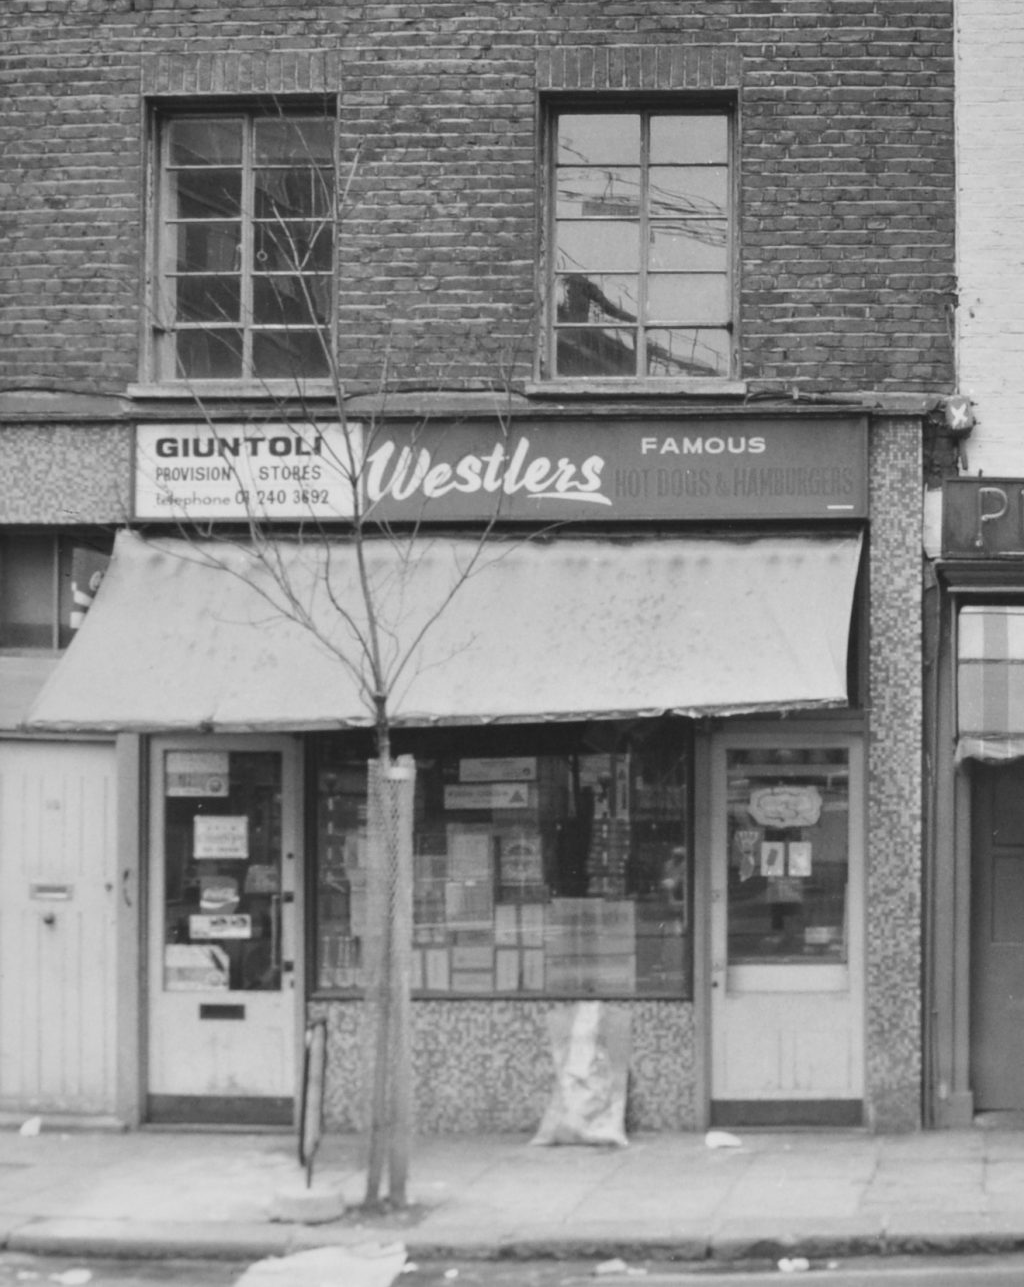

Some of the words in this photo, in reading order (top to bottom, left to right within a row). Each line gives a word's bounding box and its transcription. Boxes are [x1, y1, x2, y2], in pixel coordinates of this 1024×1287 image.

[156, 436, 322, 457] GIUNTOLI
[641, 437, 766, 454] FAMOUS
[156, 466, 231, 481] PROVISION
[259, 465, 321, 480] STORES
[366, 436, 607, 502] Westlers
[615, 469, 651, 497] HOT
[657, 468, 710, 497] DOGS
[733, 467, 853, 496] HAMBURGERS
[156, 490, 230, 508] telephone
[257, 489, 286, 504] 240
